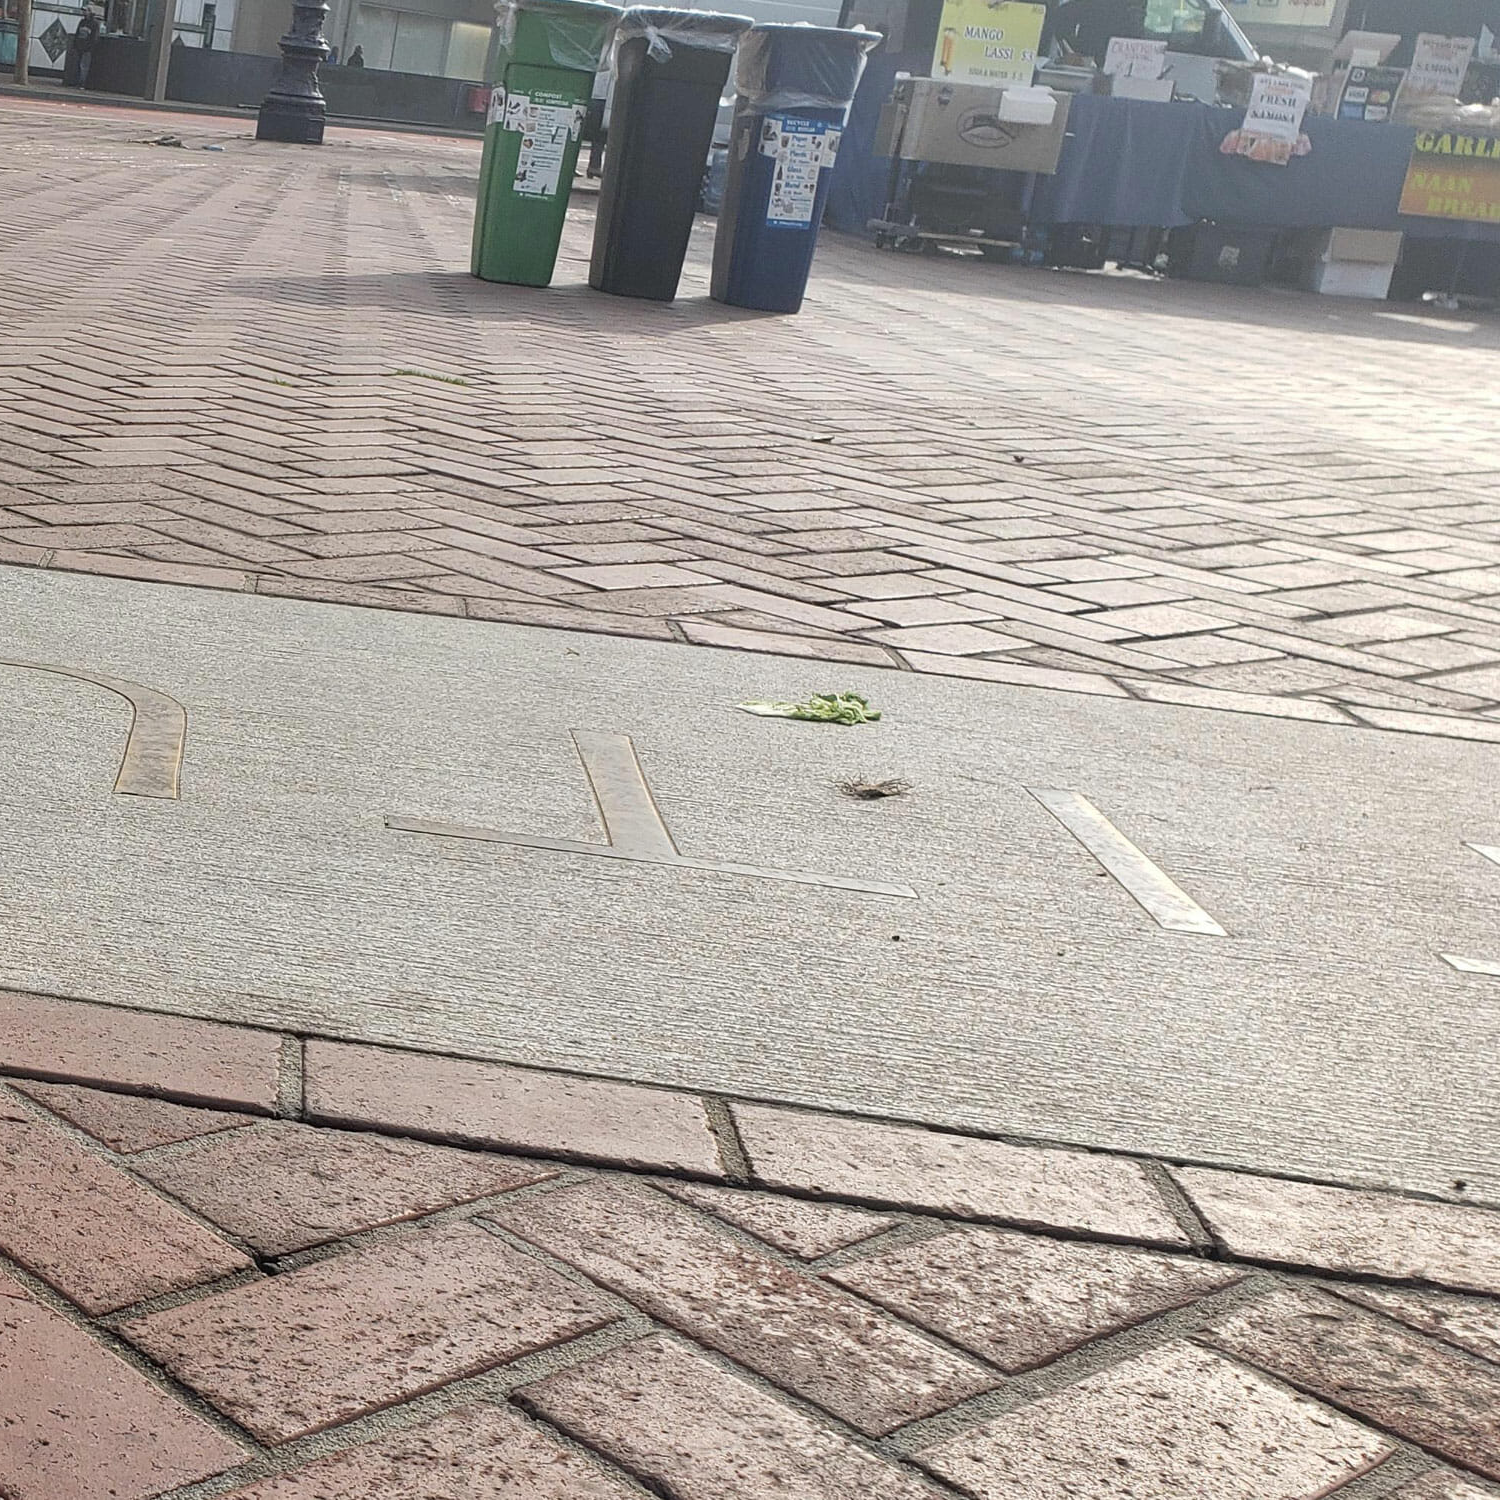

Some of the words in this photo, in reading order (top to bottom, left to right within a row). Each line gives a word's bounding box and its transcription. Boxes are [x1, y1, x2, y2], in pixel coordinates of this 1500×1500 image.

[964, 26, 1004, 40] MANGO
[985, 46, 1014, 59] LASSI
[1260, 94, 1297, 107] FRESH
[1250, 110, 1295, 124] SAMOSA
[1412, 172, 1472, 193] NAAN
